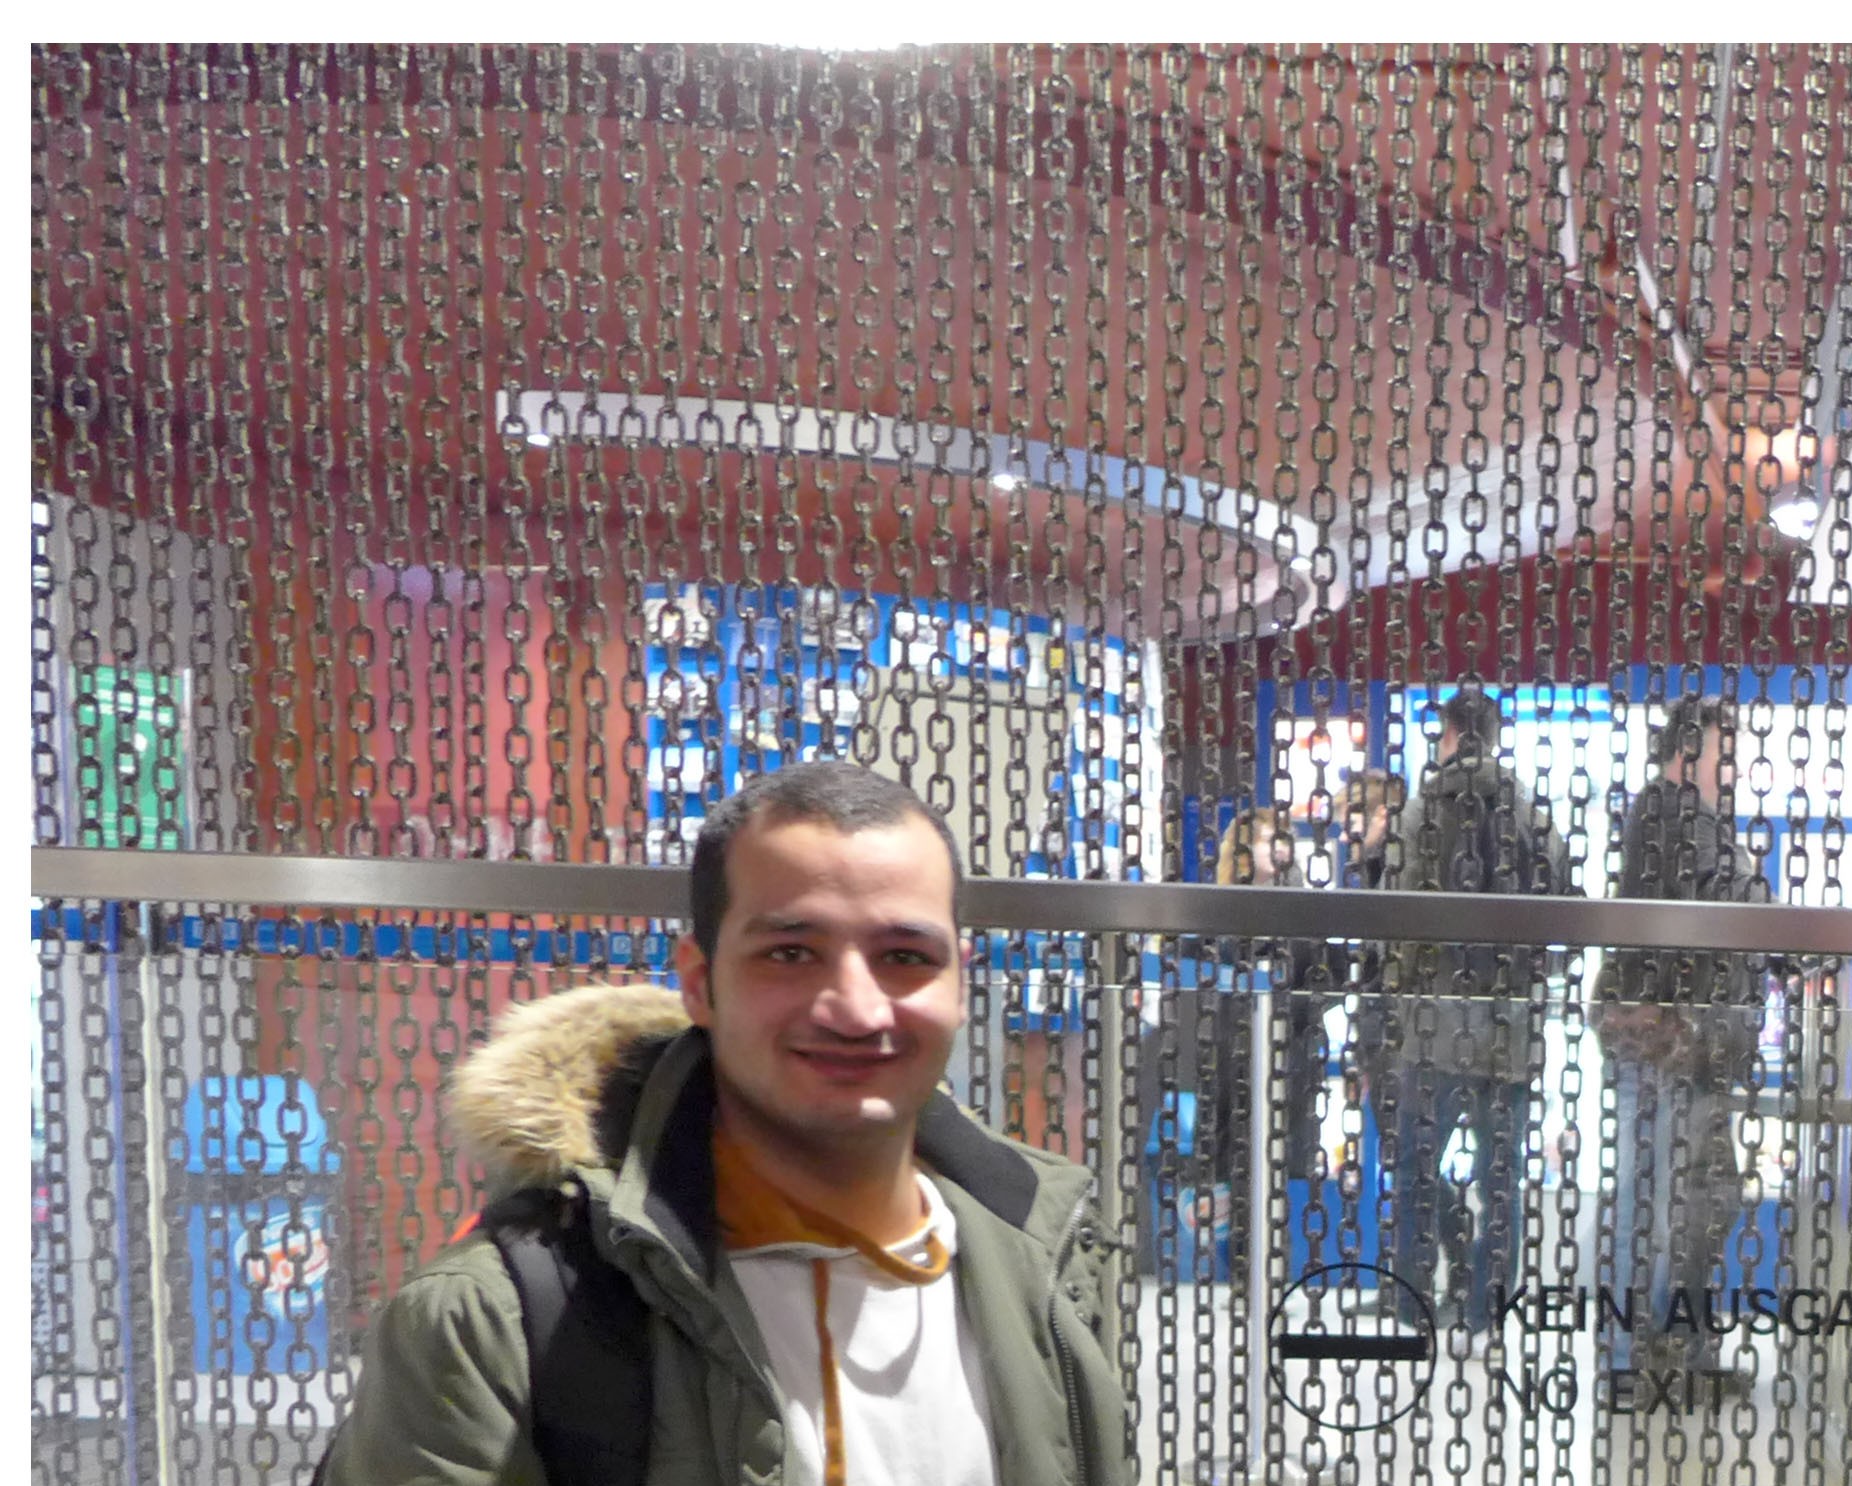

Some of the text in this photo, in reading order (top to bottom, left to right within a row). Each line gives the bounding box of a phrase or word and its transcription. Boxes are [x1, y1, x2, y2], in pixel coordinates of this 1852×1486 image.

[1495, 1284, 1633, 1332] KEIN
[1496, 1367, 1735, 1416] NO EXIT
